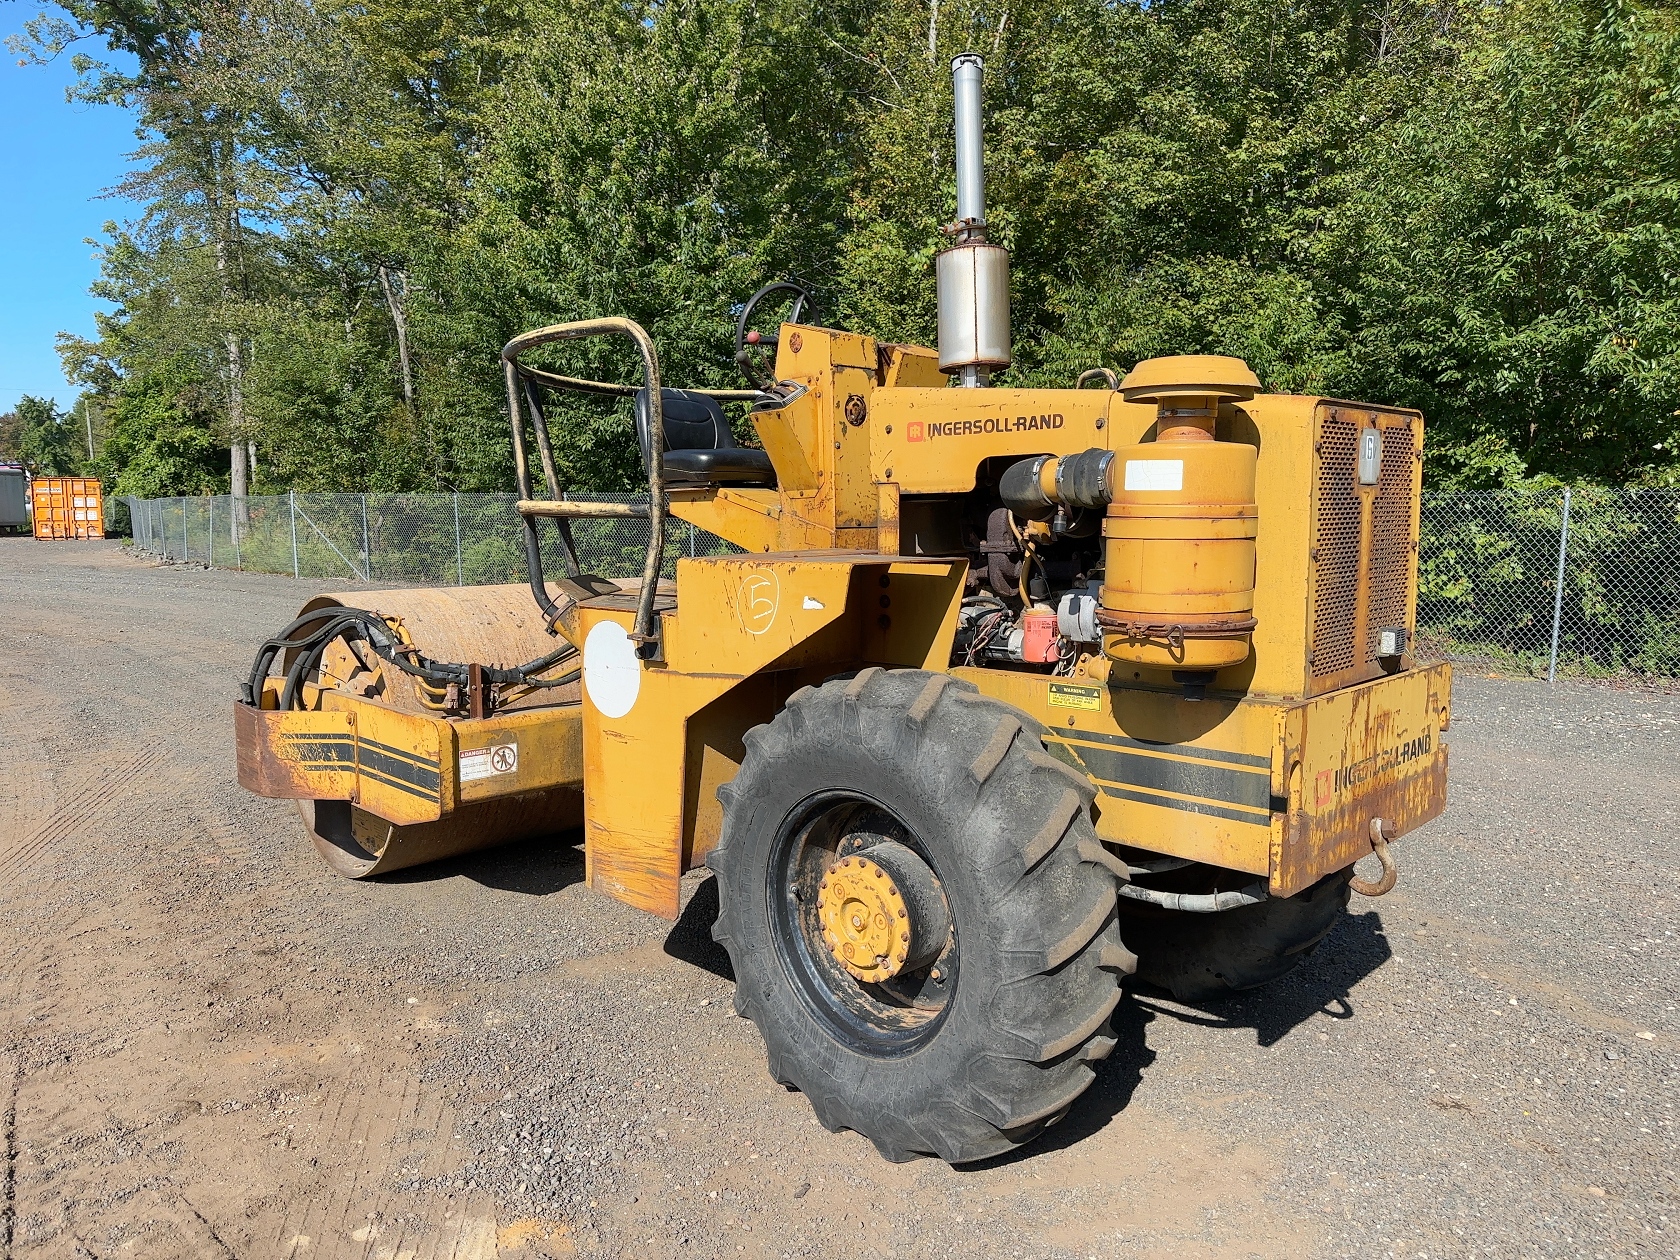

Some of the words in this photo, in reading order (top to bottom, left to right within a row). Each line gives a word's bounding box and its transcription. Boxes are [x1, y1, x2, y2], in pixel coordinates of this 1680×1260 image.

[927, 413, 1064, 437] INGERSOLL-RAND
[750, 582, 774, 619] 5
[465, 749, 487, 757] DANGER
